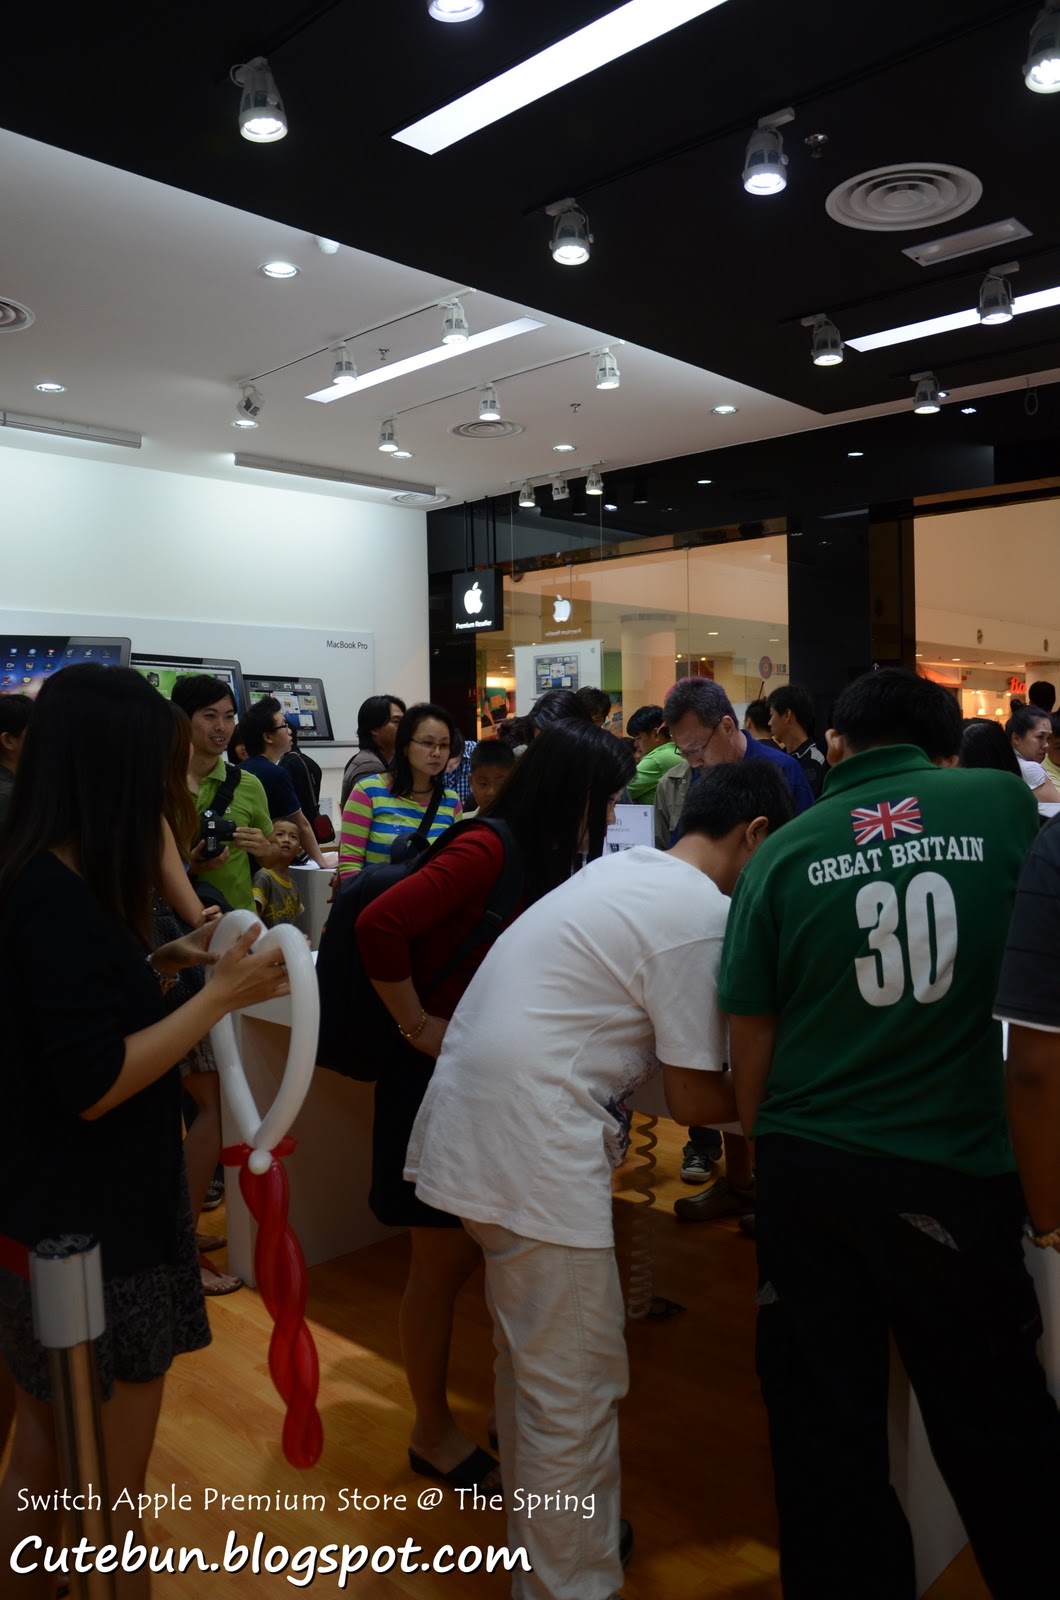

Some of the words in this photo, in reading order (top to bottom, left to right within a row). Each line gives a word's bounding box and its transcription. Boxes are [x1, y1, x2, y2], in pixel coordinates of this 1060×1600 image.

[455, 621, 475, 630] Premium
[475, 619, 492, 628] Reseller
[326, 639, 356, 650] MacBook
[357, 641, 369, 650] Pro
[807, 847, 883, 887] GREAT
[888, 835, 984, 869] BRITAIN
[854, 870, 959, 1008] 30
